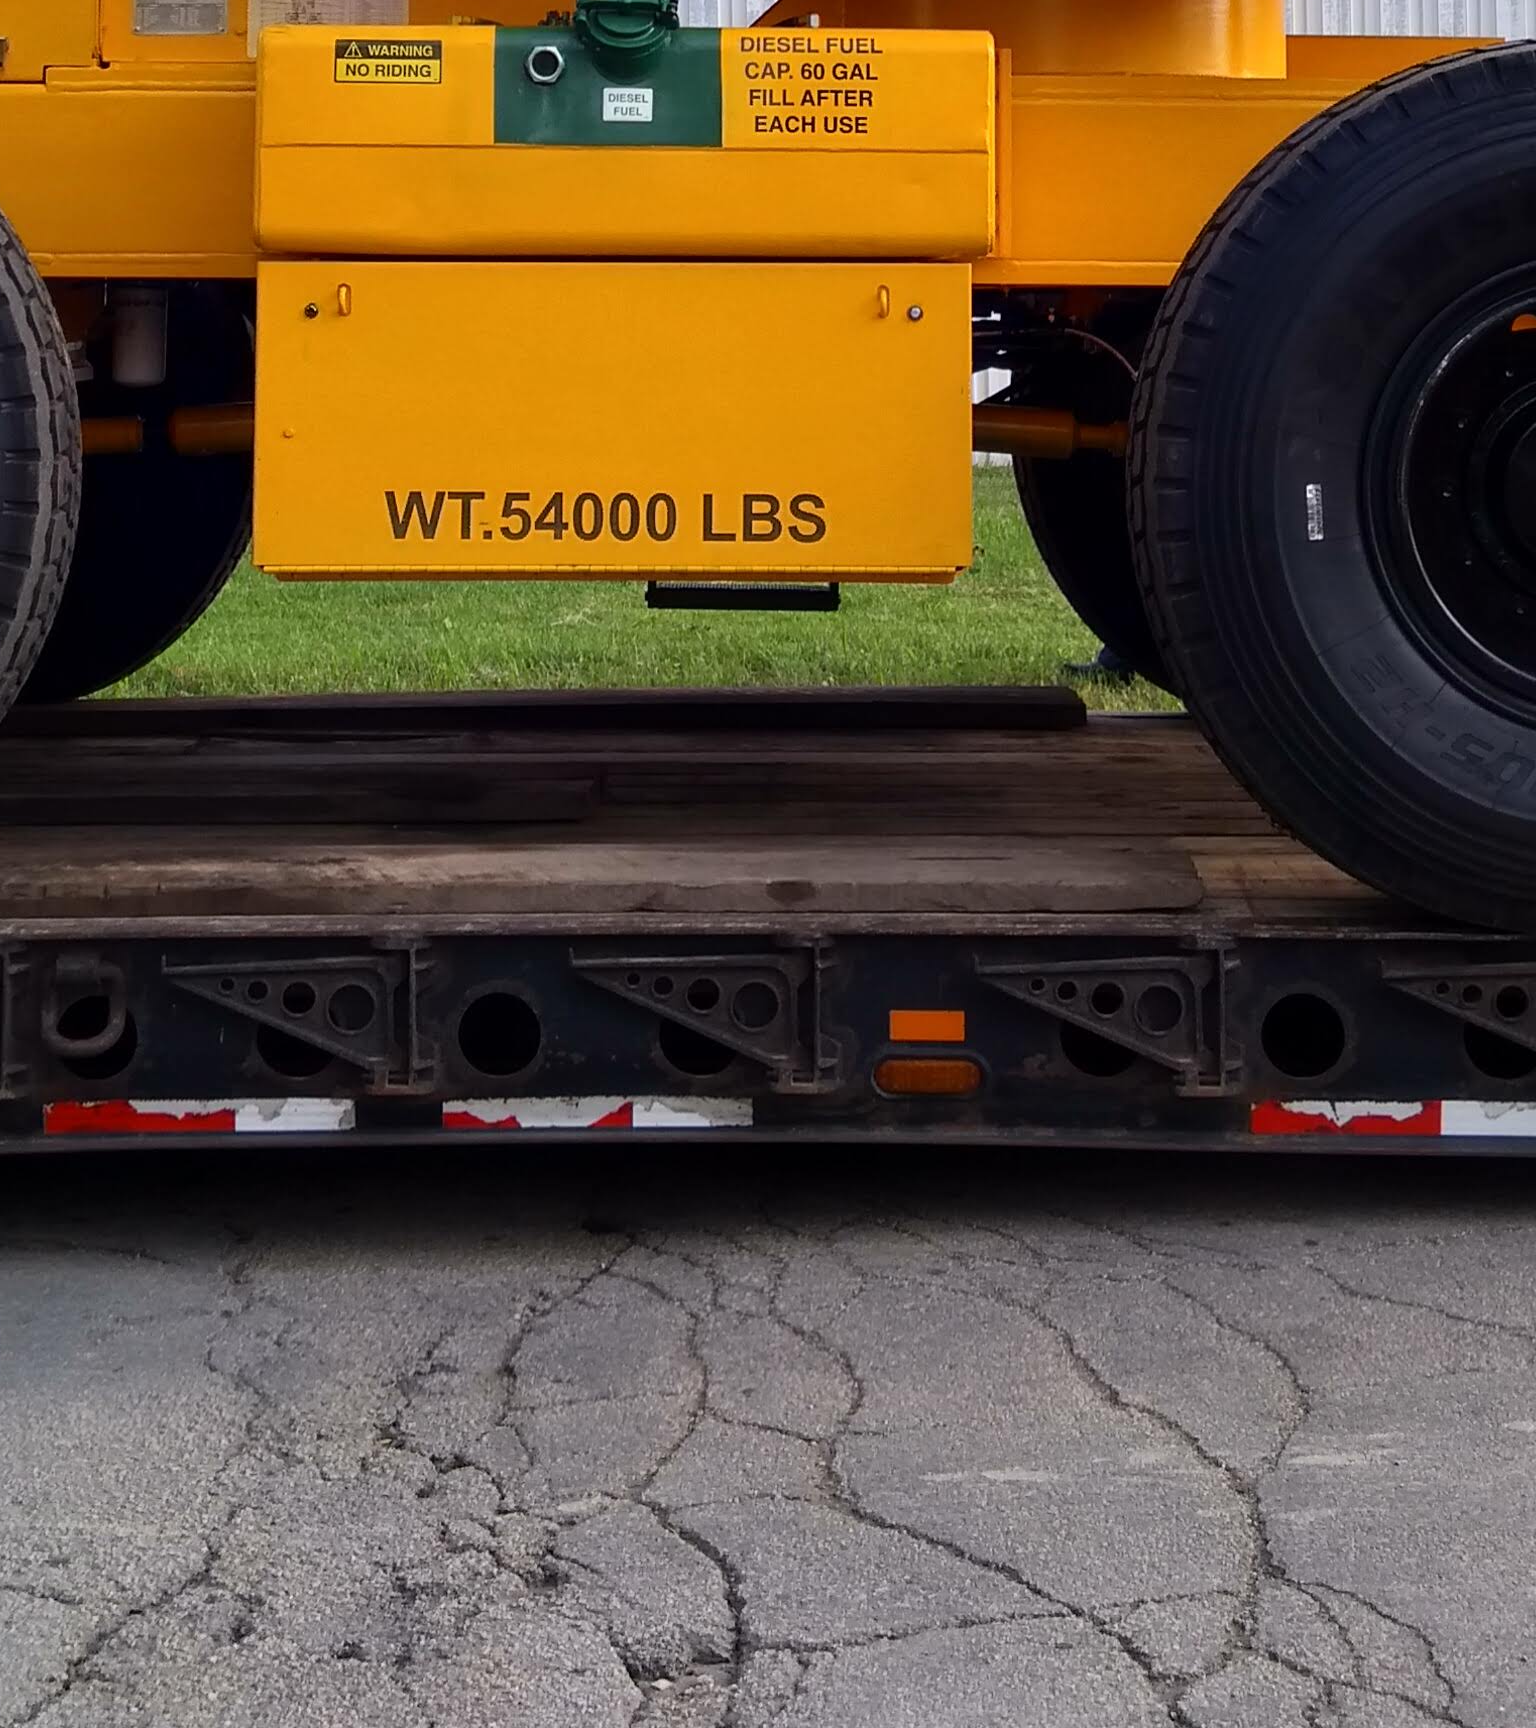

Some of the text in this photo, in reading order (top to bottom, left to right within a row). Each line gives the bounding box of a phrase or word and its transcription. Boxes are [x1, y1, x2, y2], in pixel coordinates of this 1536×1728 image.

[367, 44, 433, 57] WARNING
[740, 36, 883, 54] DIESEL FUEL
[345, 64, 432, 77] NO RIDING
[744, 62, 879, 80] CAP. 60 GAL
[608, 93, 649, 103] DIESEL
[749, 89, 873, 107] FILL AFTER
[614, 106, 643, 116] FUEL
[754, 115, 868, 134] EACH USE
[702, 493, 828, 544] LBS
